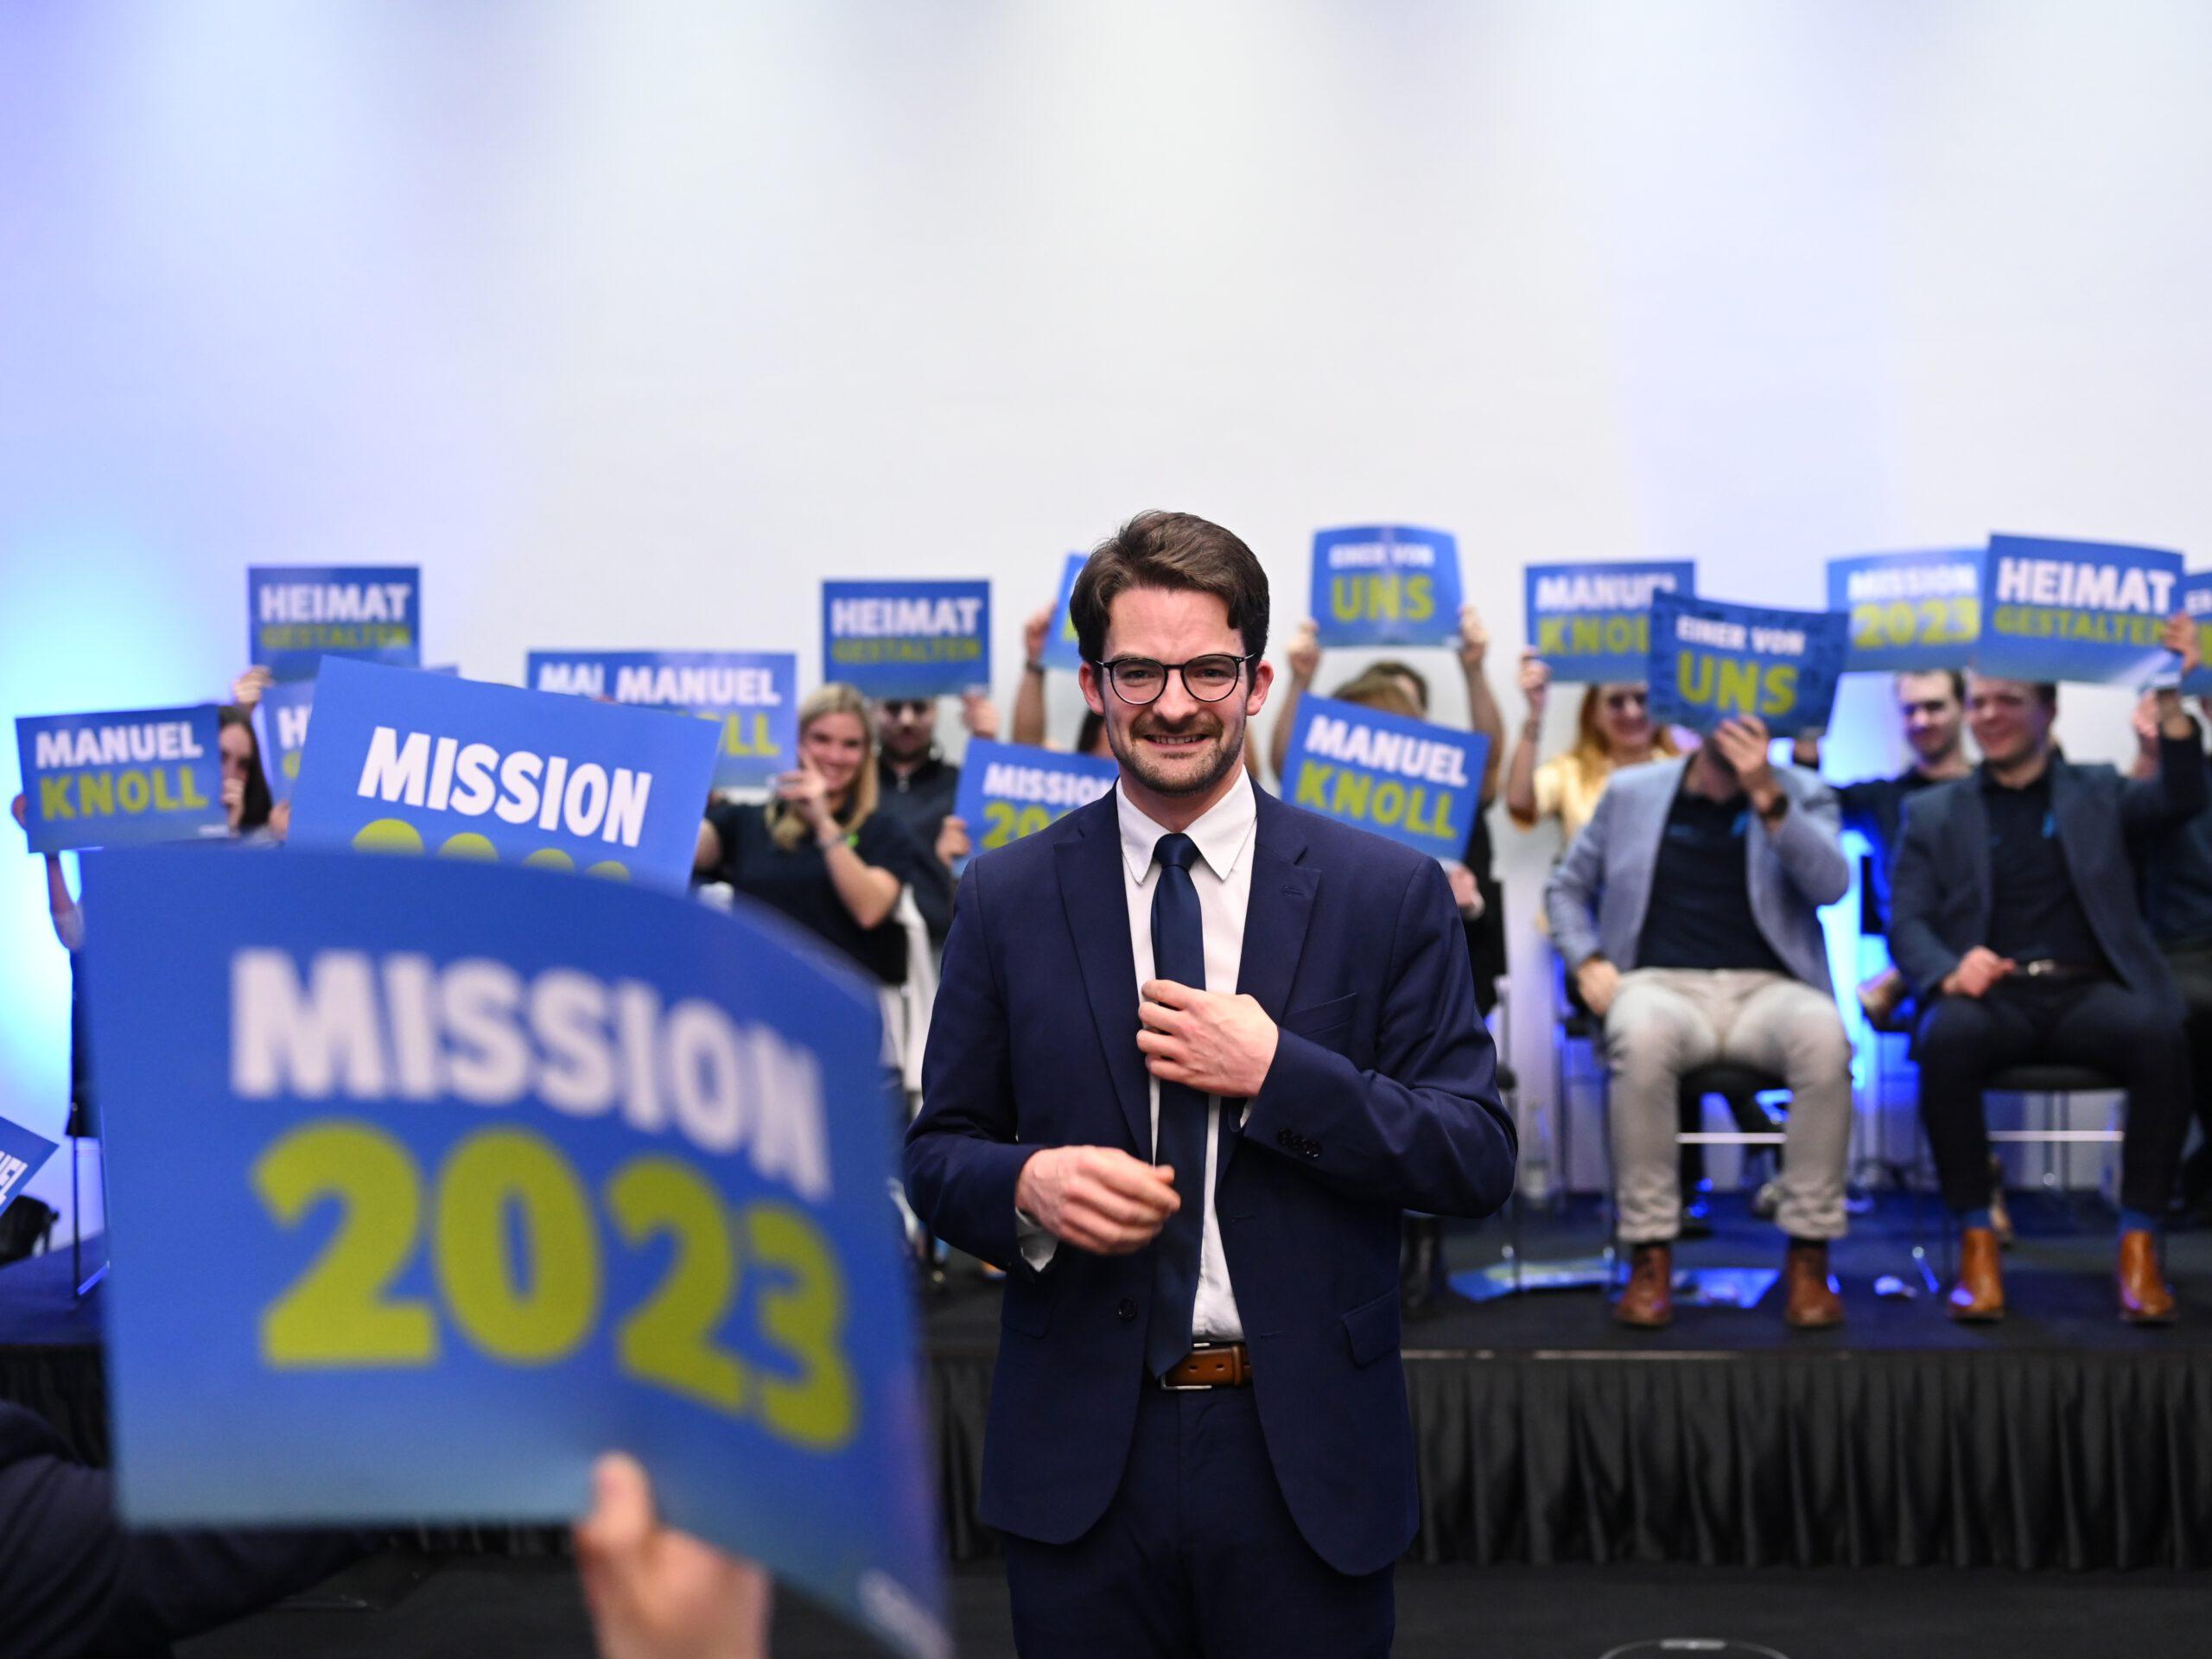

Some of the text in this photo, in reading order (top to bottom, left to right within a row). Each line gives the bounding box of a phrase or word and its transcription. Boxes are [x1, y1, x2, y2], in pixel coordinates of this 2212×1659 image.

[259, 583, 412, 623] HEIMAT
[1332, 575, 1435, 625] UNS
[1996, 556, 2177, 614] HEIMAT
[832, 598, 983, 637] HEIMAT
[1853, 596, 1981, 648] 2023
[616, 664, 782, 706] MANUEL
[1677, 650, 1799, 715] UNS
[36, 721, 203, 769] MANUEL
[1305, 714, 1468, 788] MANUEL
[40, 766, 208, 821] KNOLL
[357, 726, 652, 848] MISSION
[1296, 760, 1458, 839] KNOLL
[232, 949, 835, 1204] MISSION
[252, 1117, 859, 1450] 2023
